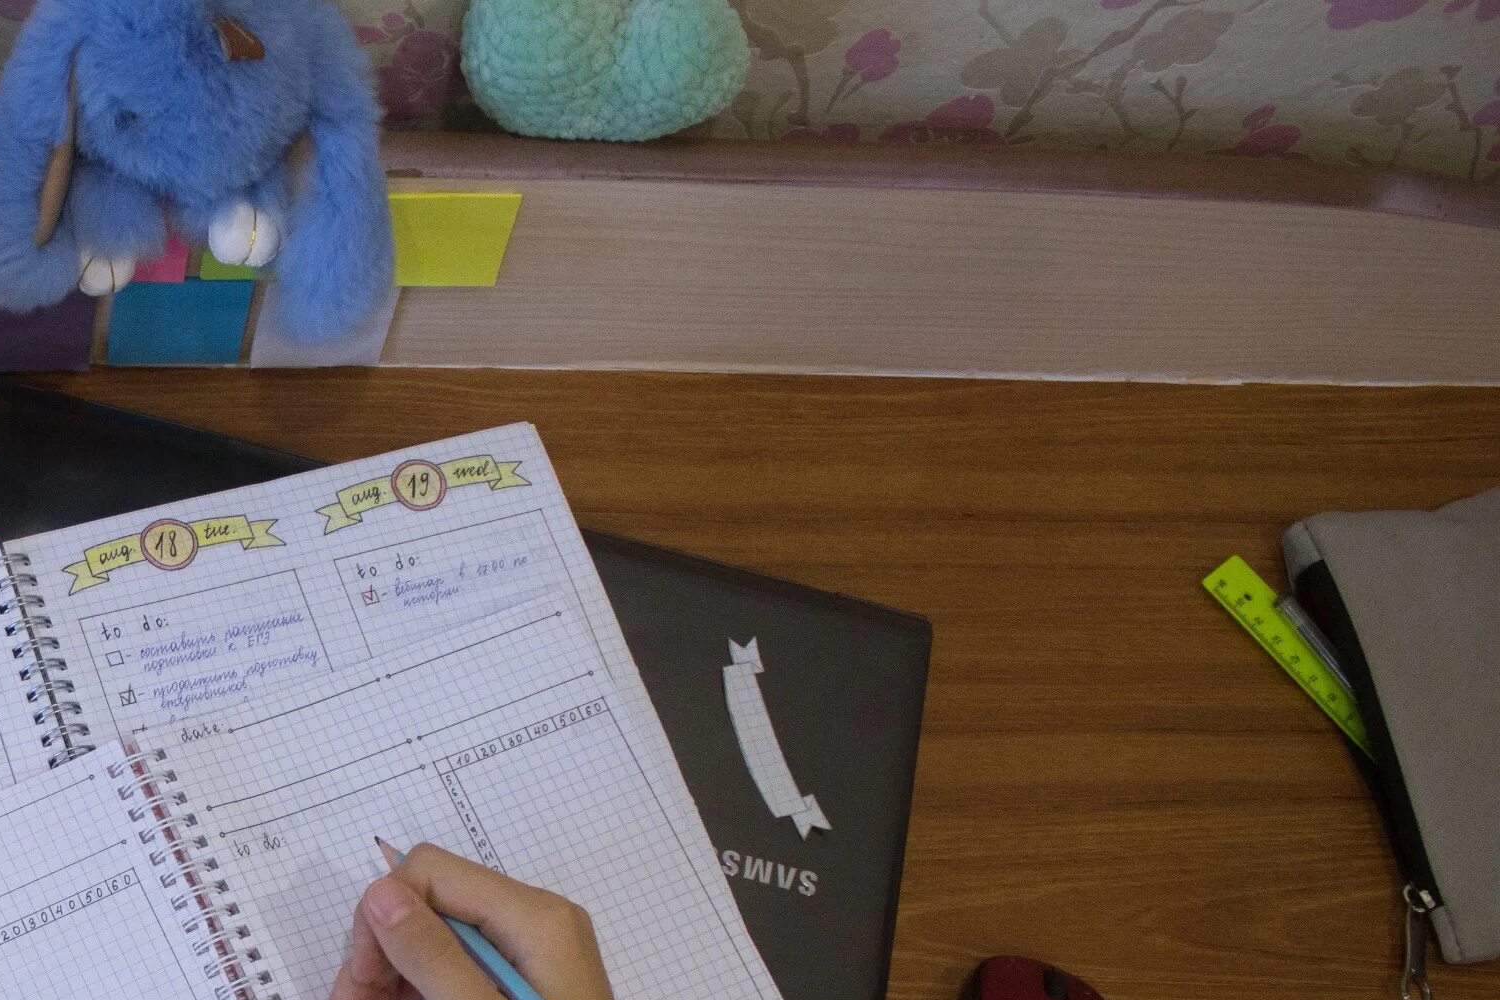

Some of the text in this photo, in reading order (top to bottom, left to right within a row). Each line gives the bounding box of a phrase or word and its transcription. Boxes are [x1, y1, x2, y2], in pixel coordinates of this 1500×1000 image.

[351, 460, 494, 506] aug. 19 wed.
[99, 522, 237, 565] aug. 18 tue.
[355, 562, 378, 580] to
[100, 613, 170, 641] to do:
[180, 722, 225, 744] date:
[455, 702, 602, 767] 10 20 30 40 50 60
[233, 832, 288, 858] to do:
[719, 849, 820, 897] SAMS
[0, 925, 22, 942] 20
[27, 911, 49, 930] 30
[56, 900, 77, 917] 40
[84, 887, 104, 905] 50
[111, 874, 132, 892] 60
